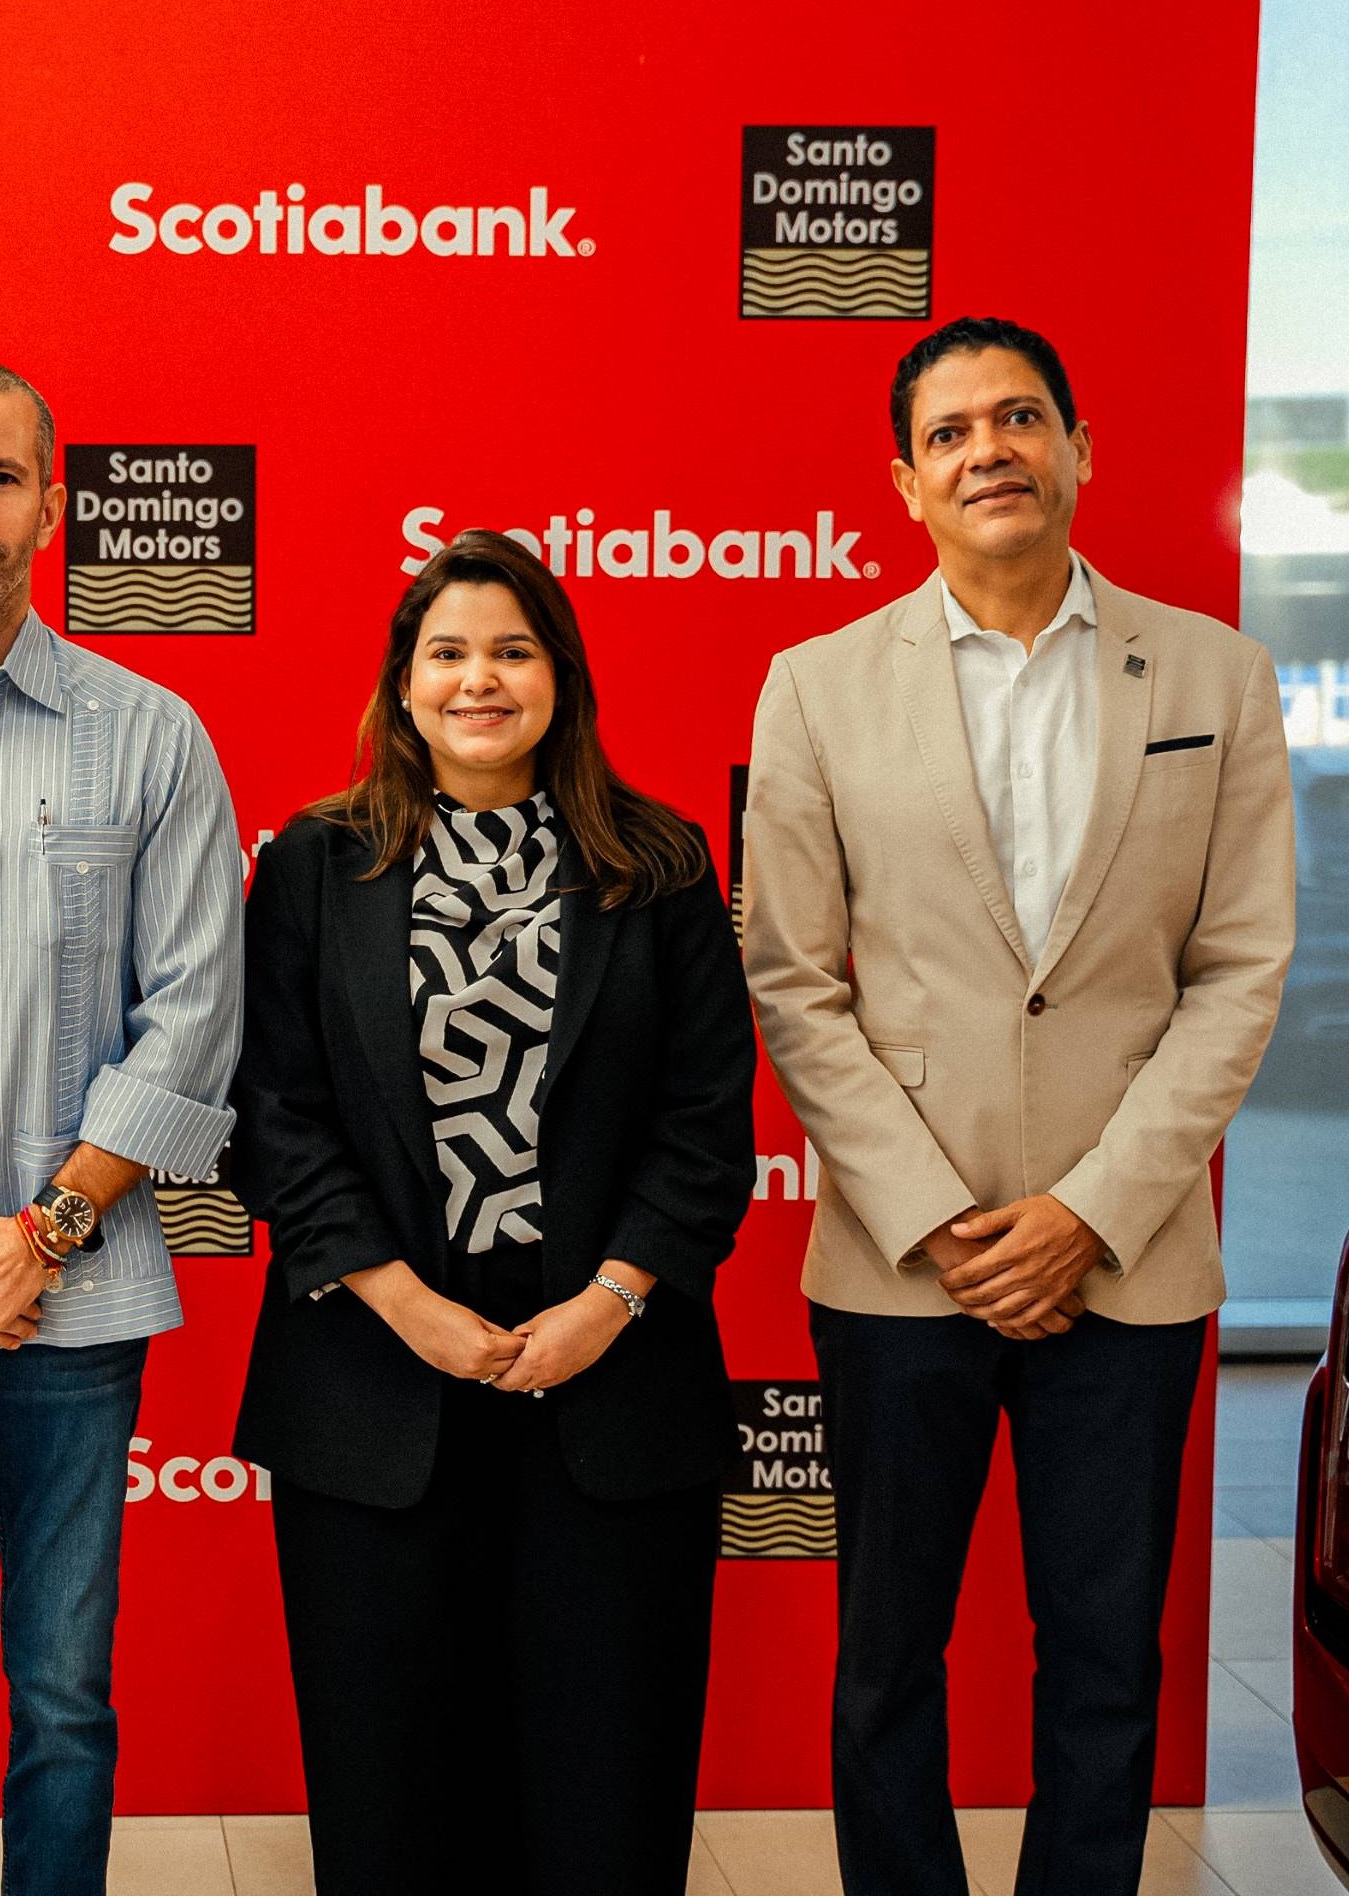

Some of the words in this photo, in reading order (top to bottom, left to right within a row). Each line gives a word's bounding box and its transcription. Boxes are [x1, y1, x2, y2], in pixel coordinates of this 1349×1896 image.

[786, 132, 893, 166] Santo
[753, 172, 923, 213] Domingo
[775, 211, 899, 244] Motors
[108, 451, 213, 484] Santo
[76, 490, 245, 529] Domingo
[99, 529, 222, 560] Motors
